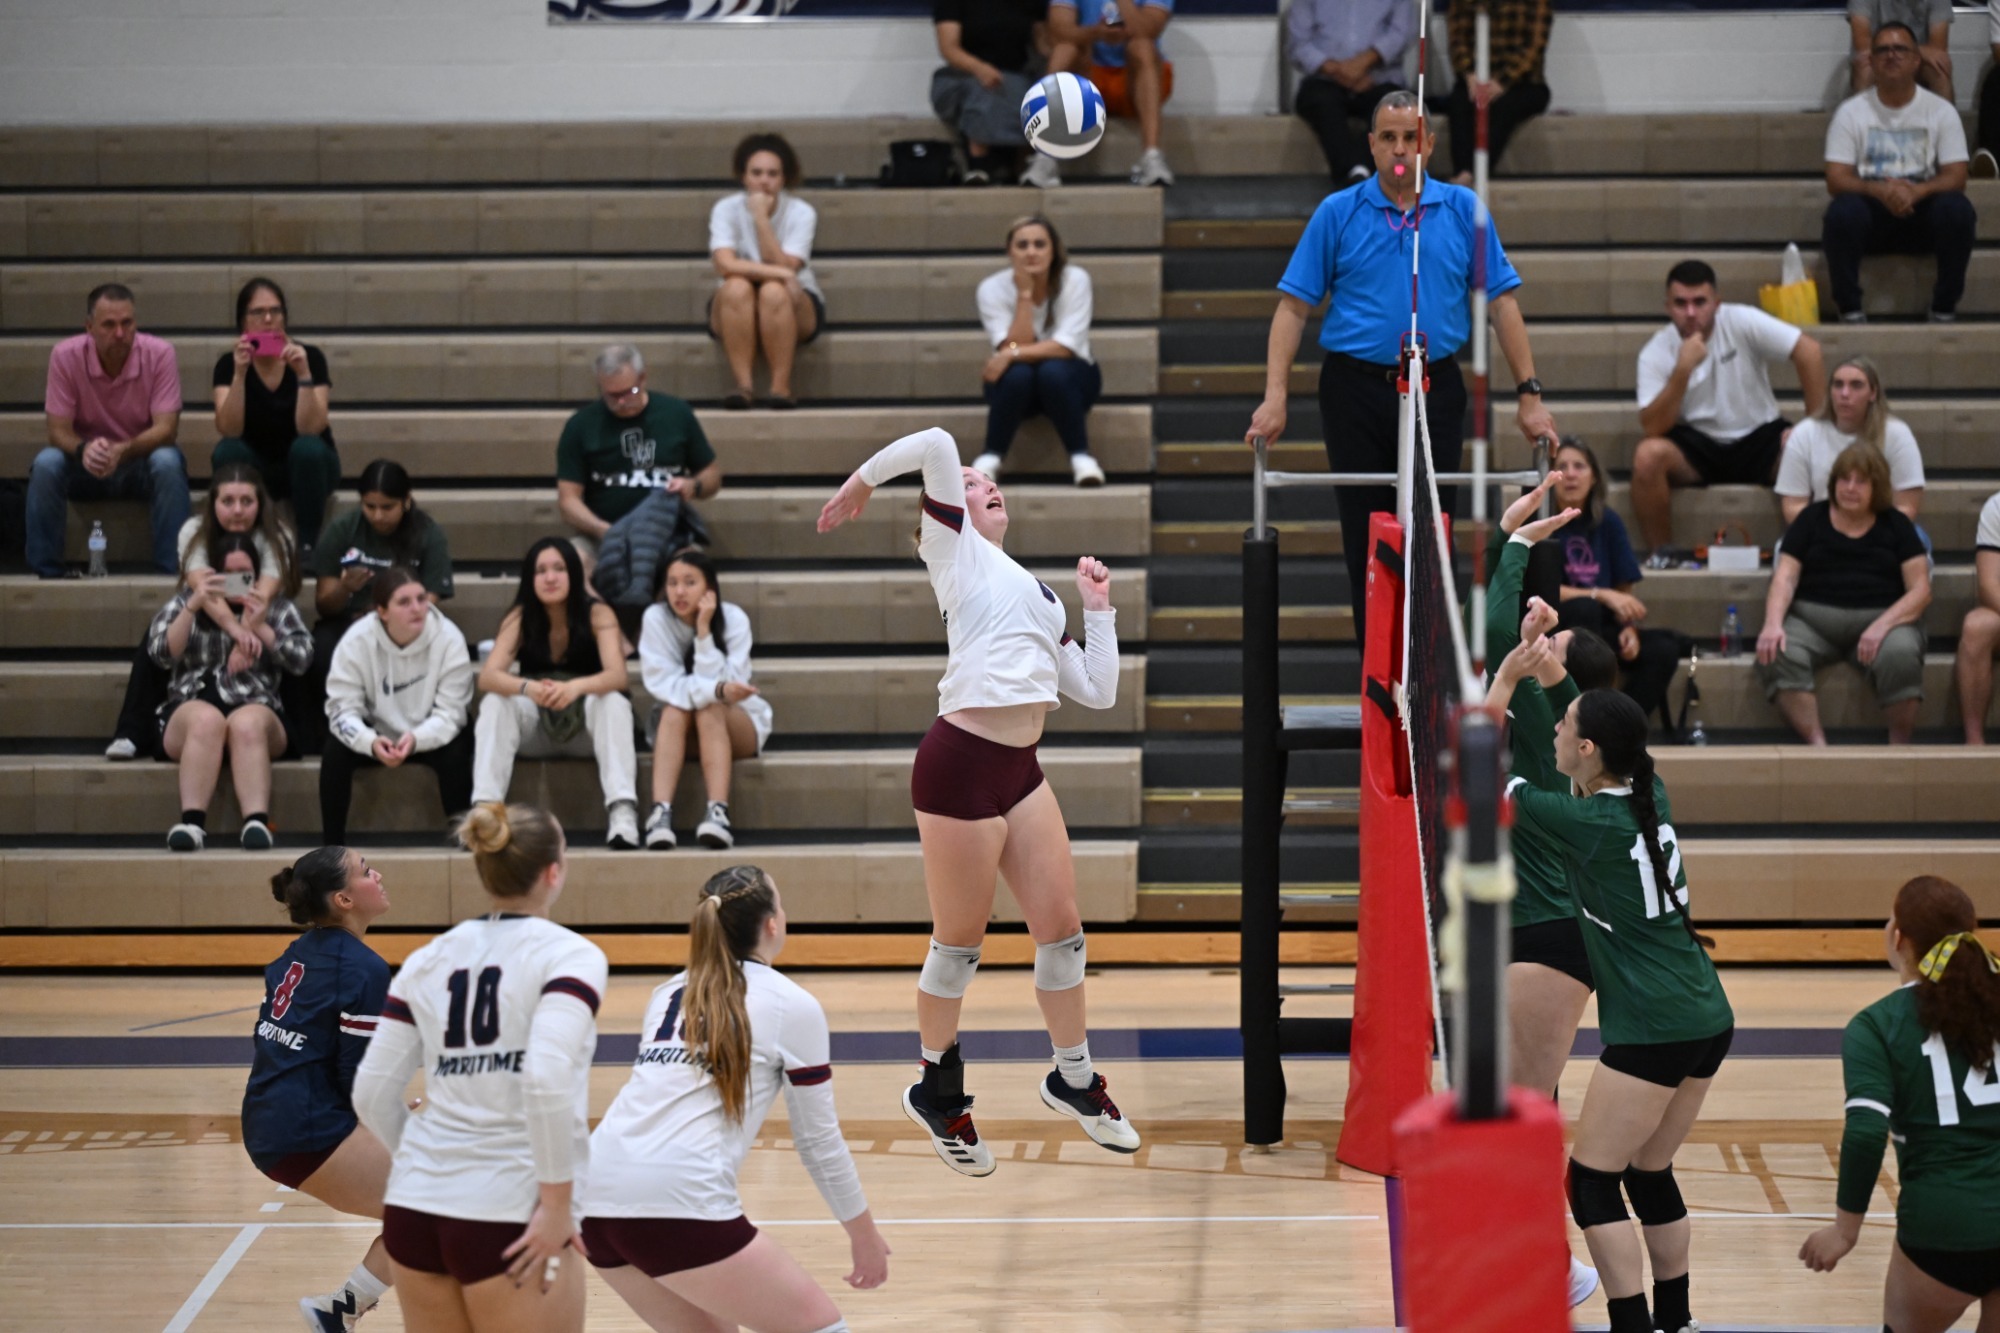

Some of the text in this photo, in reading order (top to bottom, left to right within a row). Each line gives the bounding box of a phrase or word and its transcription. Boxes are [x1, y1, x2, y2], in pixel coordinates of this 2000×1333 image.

[1630, 823, 1689, 919] 12
[271, 961, 305, 1020] 8
[258, 1019, 308, 1051] ARITIME
[434, 1049, 526, 1077] MARITIME
